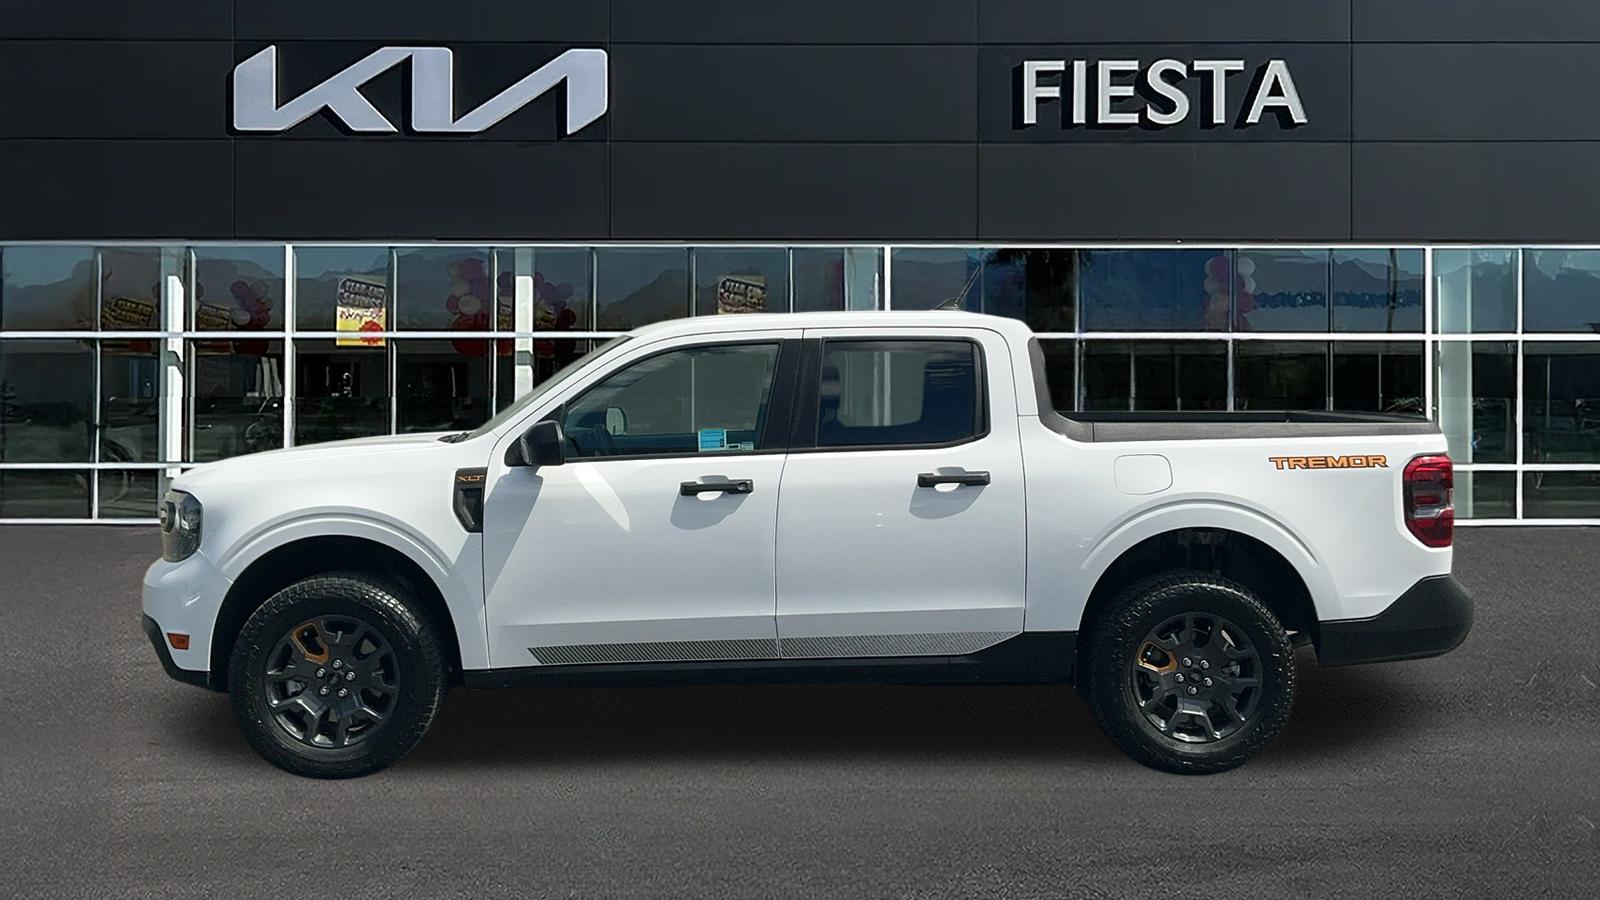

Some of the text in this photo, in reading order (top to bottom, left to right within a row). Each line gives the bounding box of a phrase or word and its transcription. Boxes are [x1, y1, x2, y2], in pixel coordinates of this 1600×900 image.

[233, 44, 608, 135] KIA
[1023, 58, 1308, 125] FIESTA
[457, 474, 485, 482] XLT
[1269, 455, 1389, 470] TREMOR
